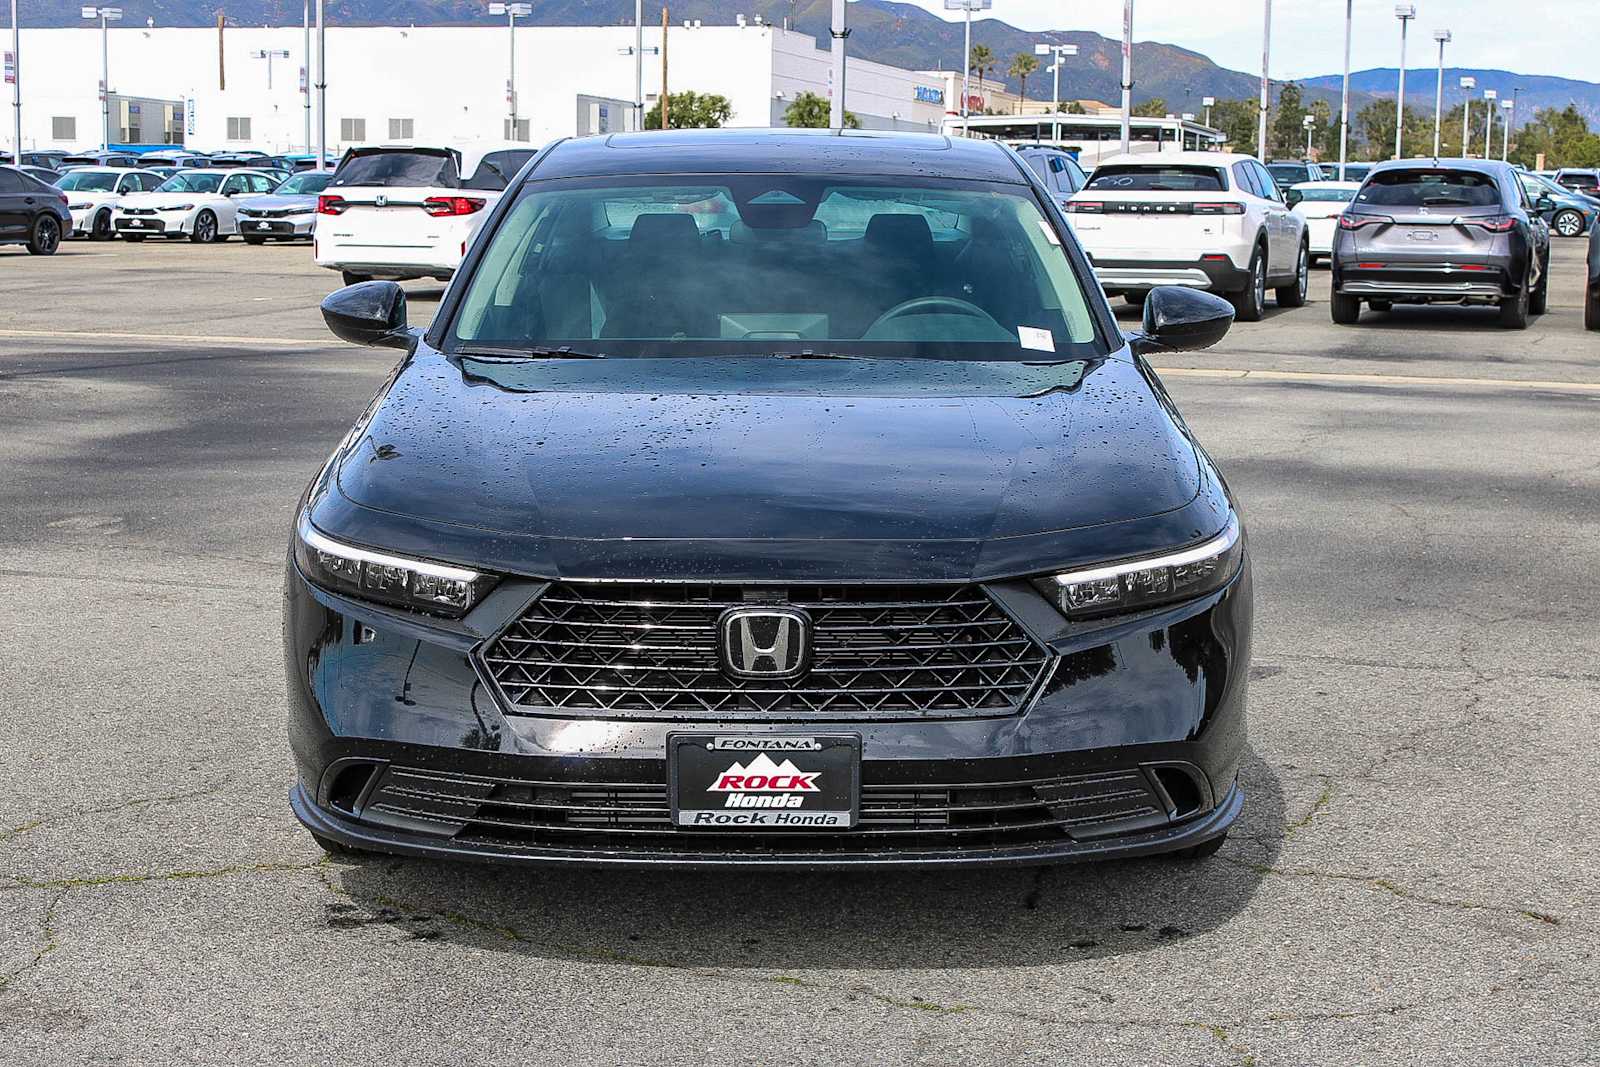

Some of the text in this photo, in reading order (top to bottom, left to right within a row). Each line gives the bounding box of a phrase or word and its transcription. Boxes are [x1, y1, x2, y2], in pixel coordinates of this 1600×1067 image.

[720, 739, 813, 750] FONTANA
[718, 775, 814, 789] ROCK
[724, 793, 804, 808] Honda
[693, 812, 838, 825] Rock Honda
